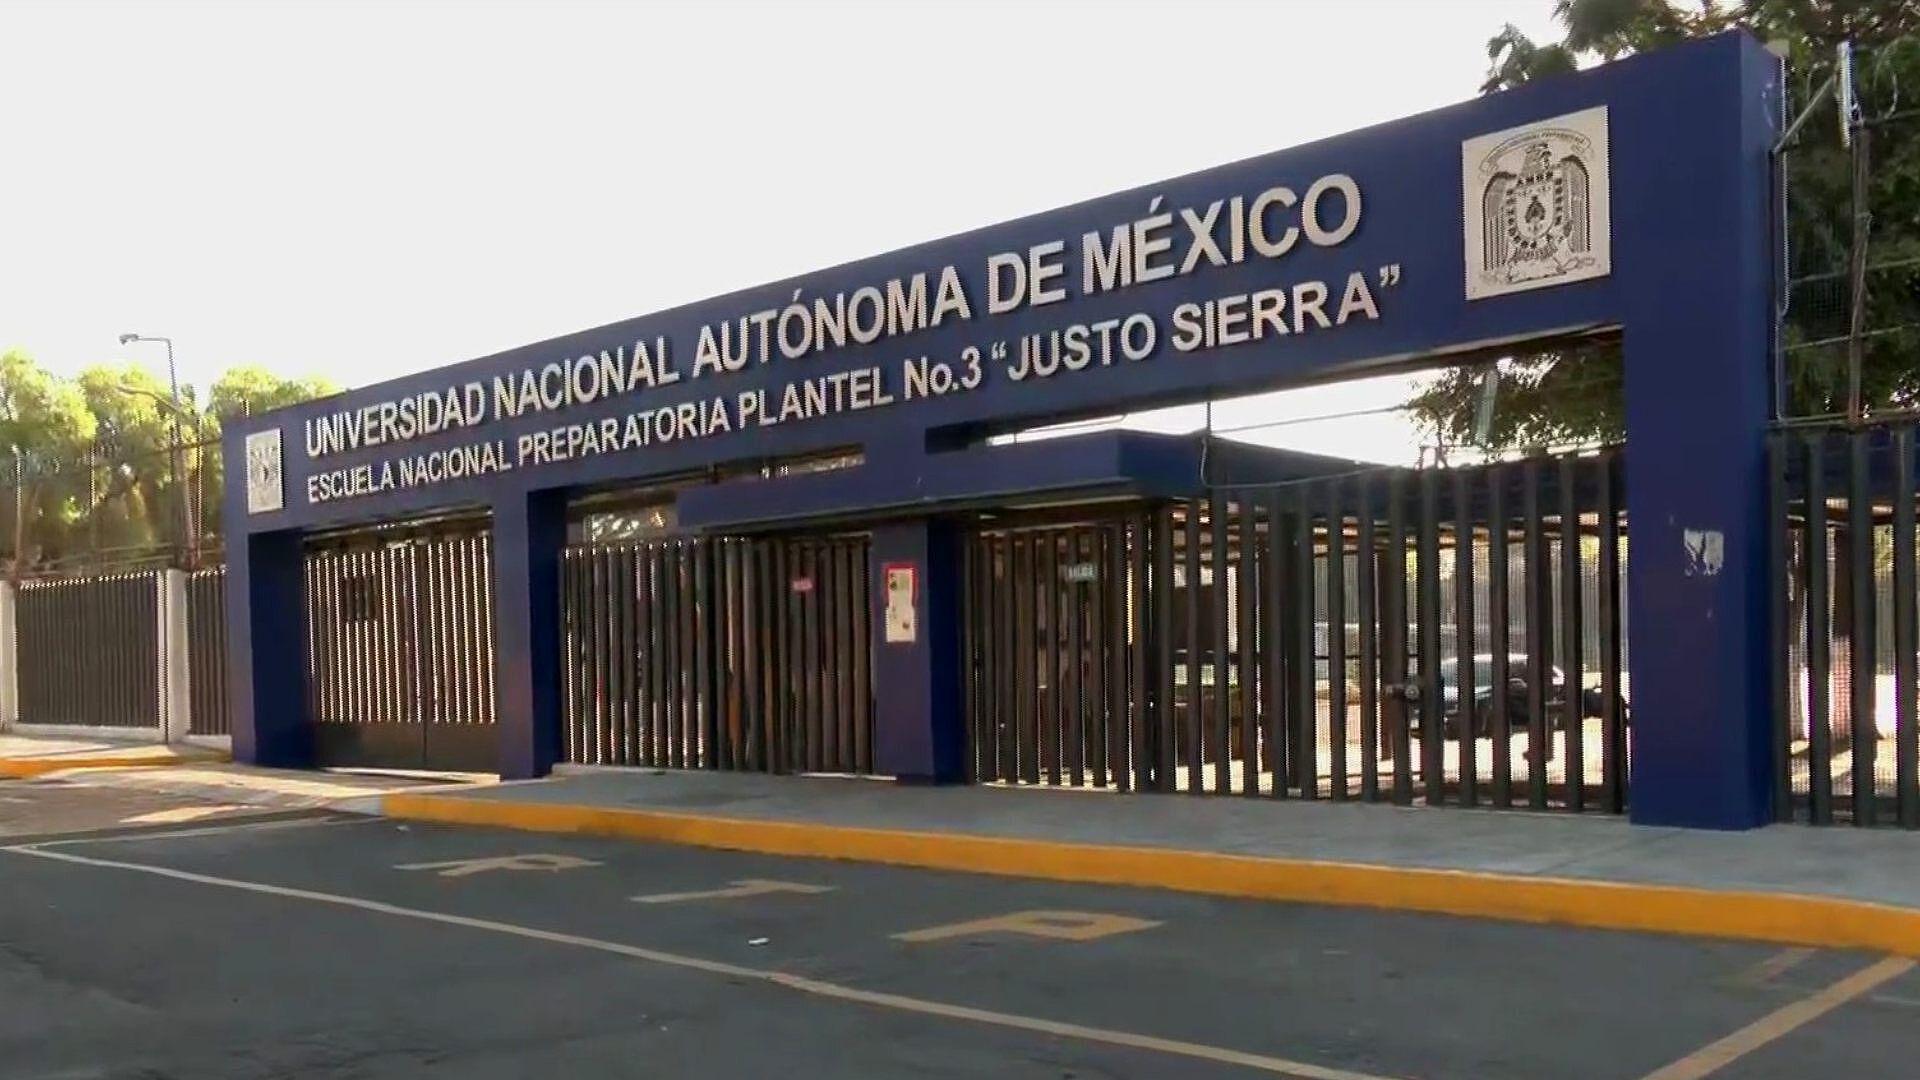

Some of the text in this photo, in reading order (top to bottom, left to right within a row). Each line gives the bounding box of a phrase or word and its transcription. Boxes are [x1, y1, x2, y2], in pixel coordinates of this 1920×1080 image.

[305, 174, 1360, 457] UNIVERSIDAD NACIONAL AUTÓNOMA DE MÉXICO
[307, 461, 395, 503] ESCUELA
[399, 440, 512, 487] NACIONAL
[518, 397, 730, 466] PREPARATORIA
[738, 367, 893, 428] PLANTEL
